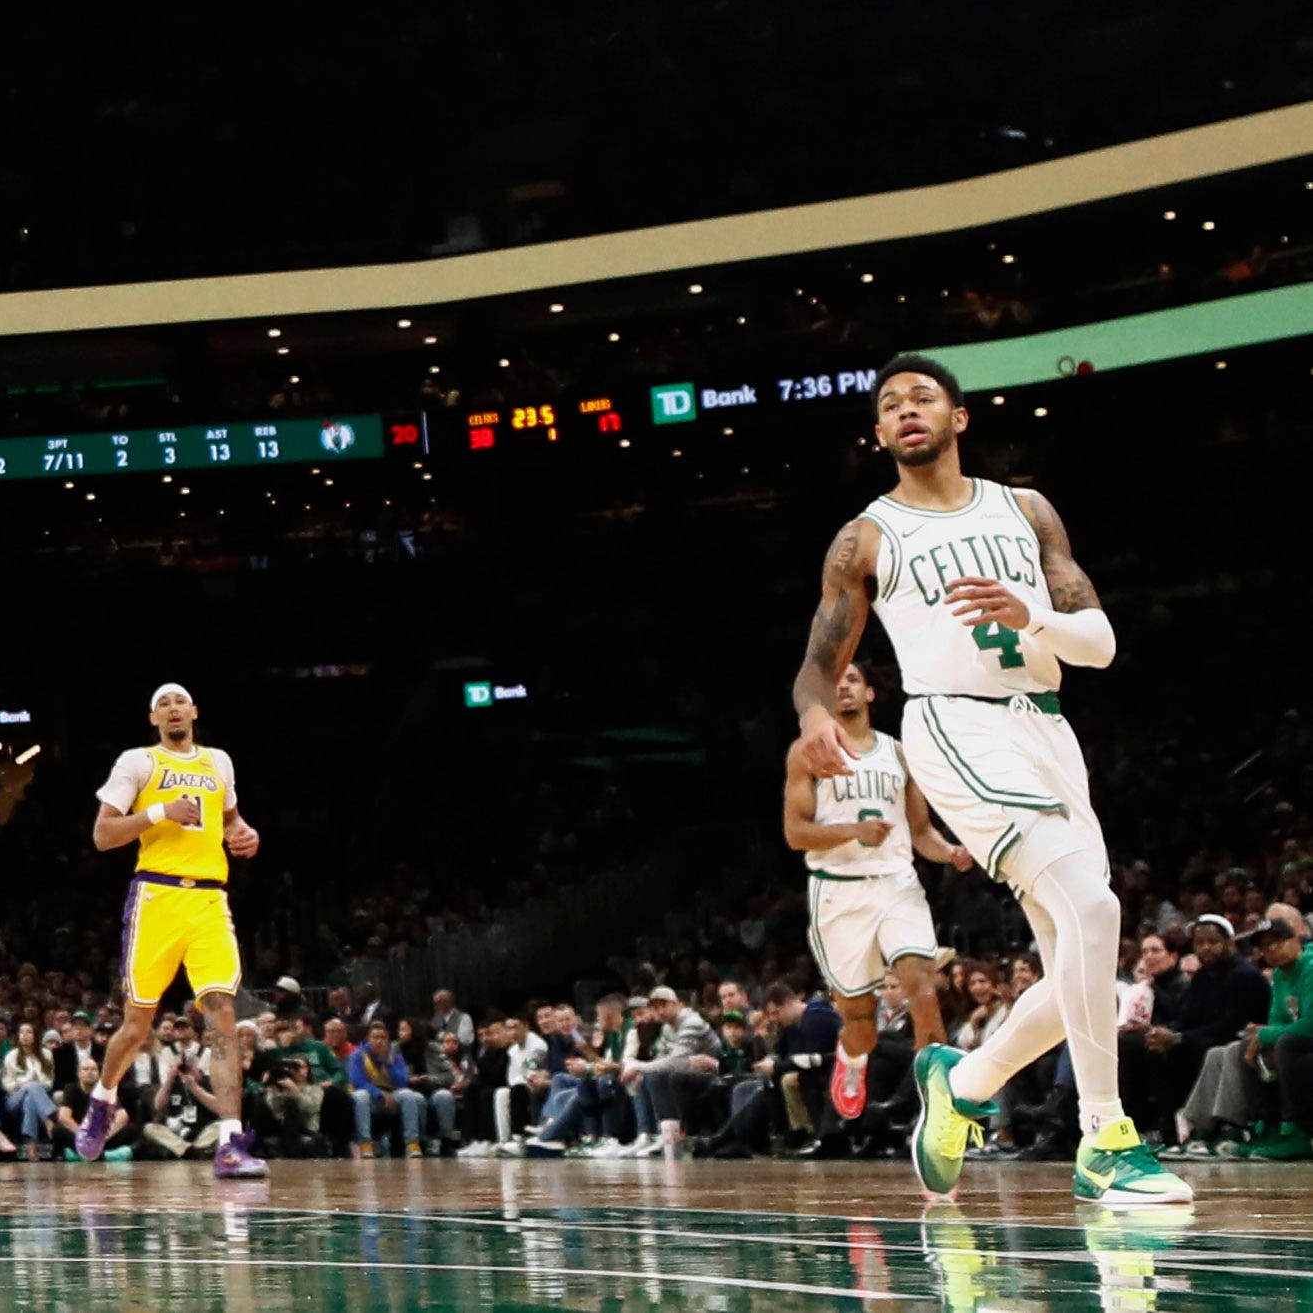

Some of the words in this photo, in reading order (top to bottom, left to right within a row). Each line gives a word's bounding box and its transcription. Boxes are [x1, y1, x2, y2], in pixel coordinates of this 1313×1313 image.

[657, 390, 690, 415] TD
[701, 385, 757, 409] Bank
[778, 374, 831, 401] 7:36
[838, 369, 876, 394] PM
[512, 406, 554, 428] 23.5
[48, 439, 68, 449] 3PT
[112, 436, 128, 445] TO
[159, 432, 177, 443] STL
[206, 429, 228, 439] AST
[255, 426, 276, 436] REB
[391, 424, 418, 444] 20
[44, 453, 84, 471] 7/11
[117, 450, 128, 466] 2
[165, 447, 176, 464] 3
[211, 444, 230, 461] 13
[258, 441, 279, 458] 13
[909, 534, 1036, 606] CELTICS
[971, 608, 1026, 669] 4
[468, 685, 490, 703] TD
[494, 683, 527, 699] Bank
[0, 709, 30, 724] Bank
[158, 769, 217, 792] LAKERS
[832, 769, 901, 805] CELTICS
